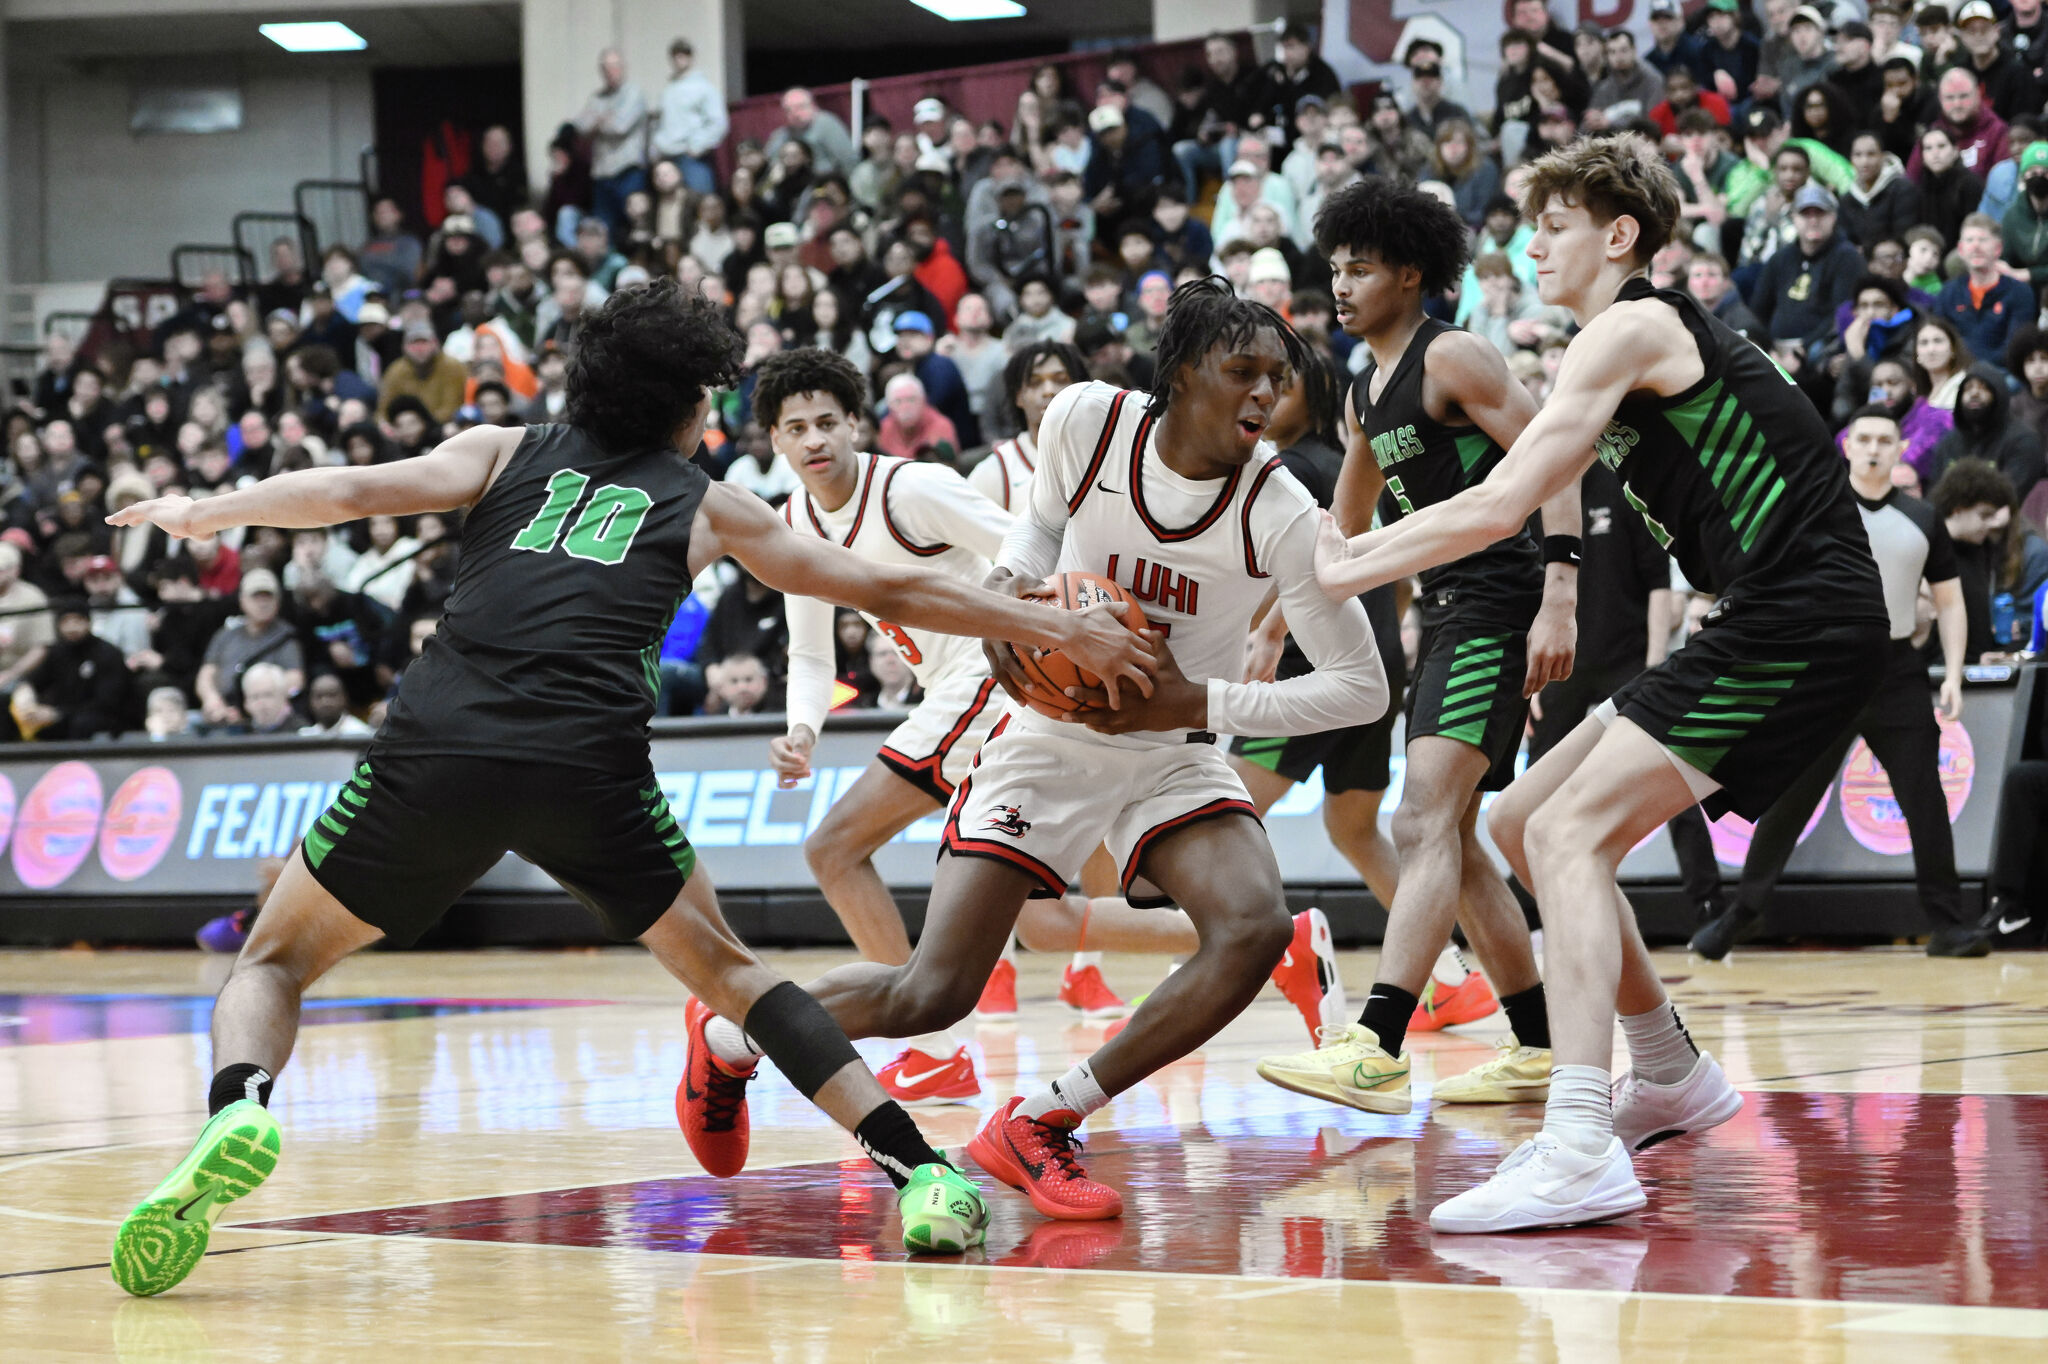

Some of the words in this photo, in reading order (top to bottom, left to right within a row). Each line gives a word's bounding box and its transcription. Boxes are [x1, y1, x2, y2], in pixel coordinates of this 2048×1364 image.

[510, 468, 655, 565] 10
[1386, 475, 1415, 514] 5
[1107, 553, 1199, 616] LUHI
